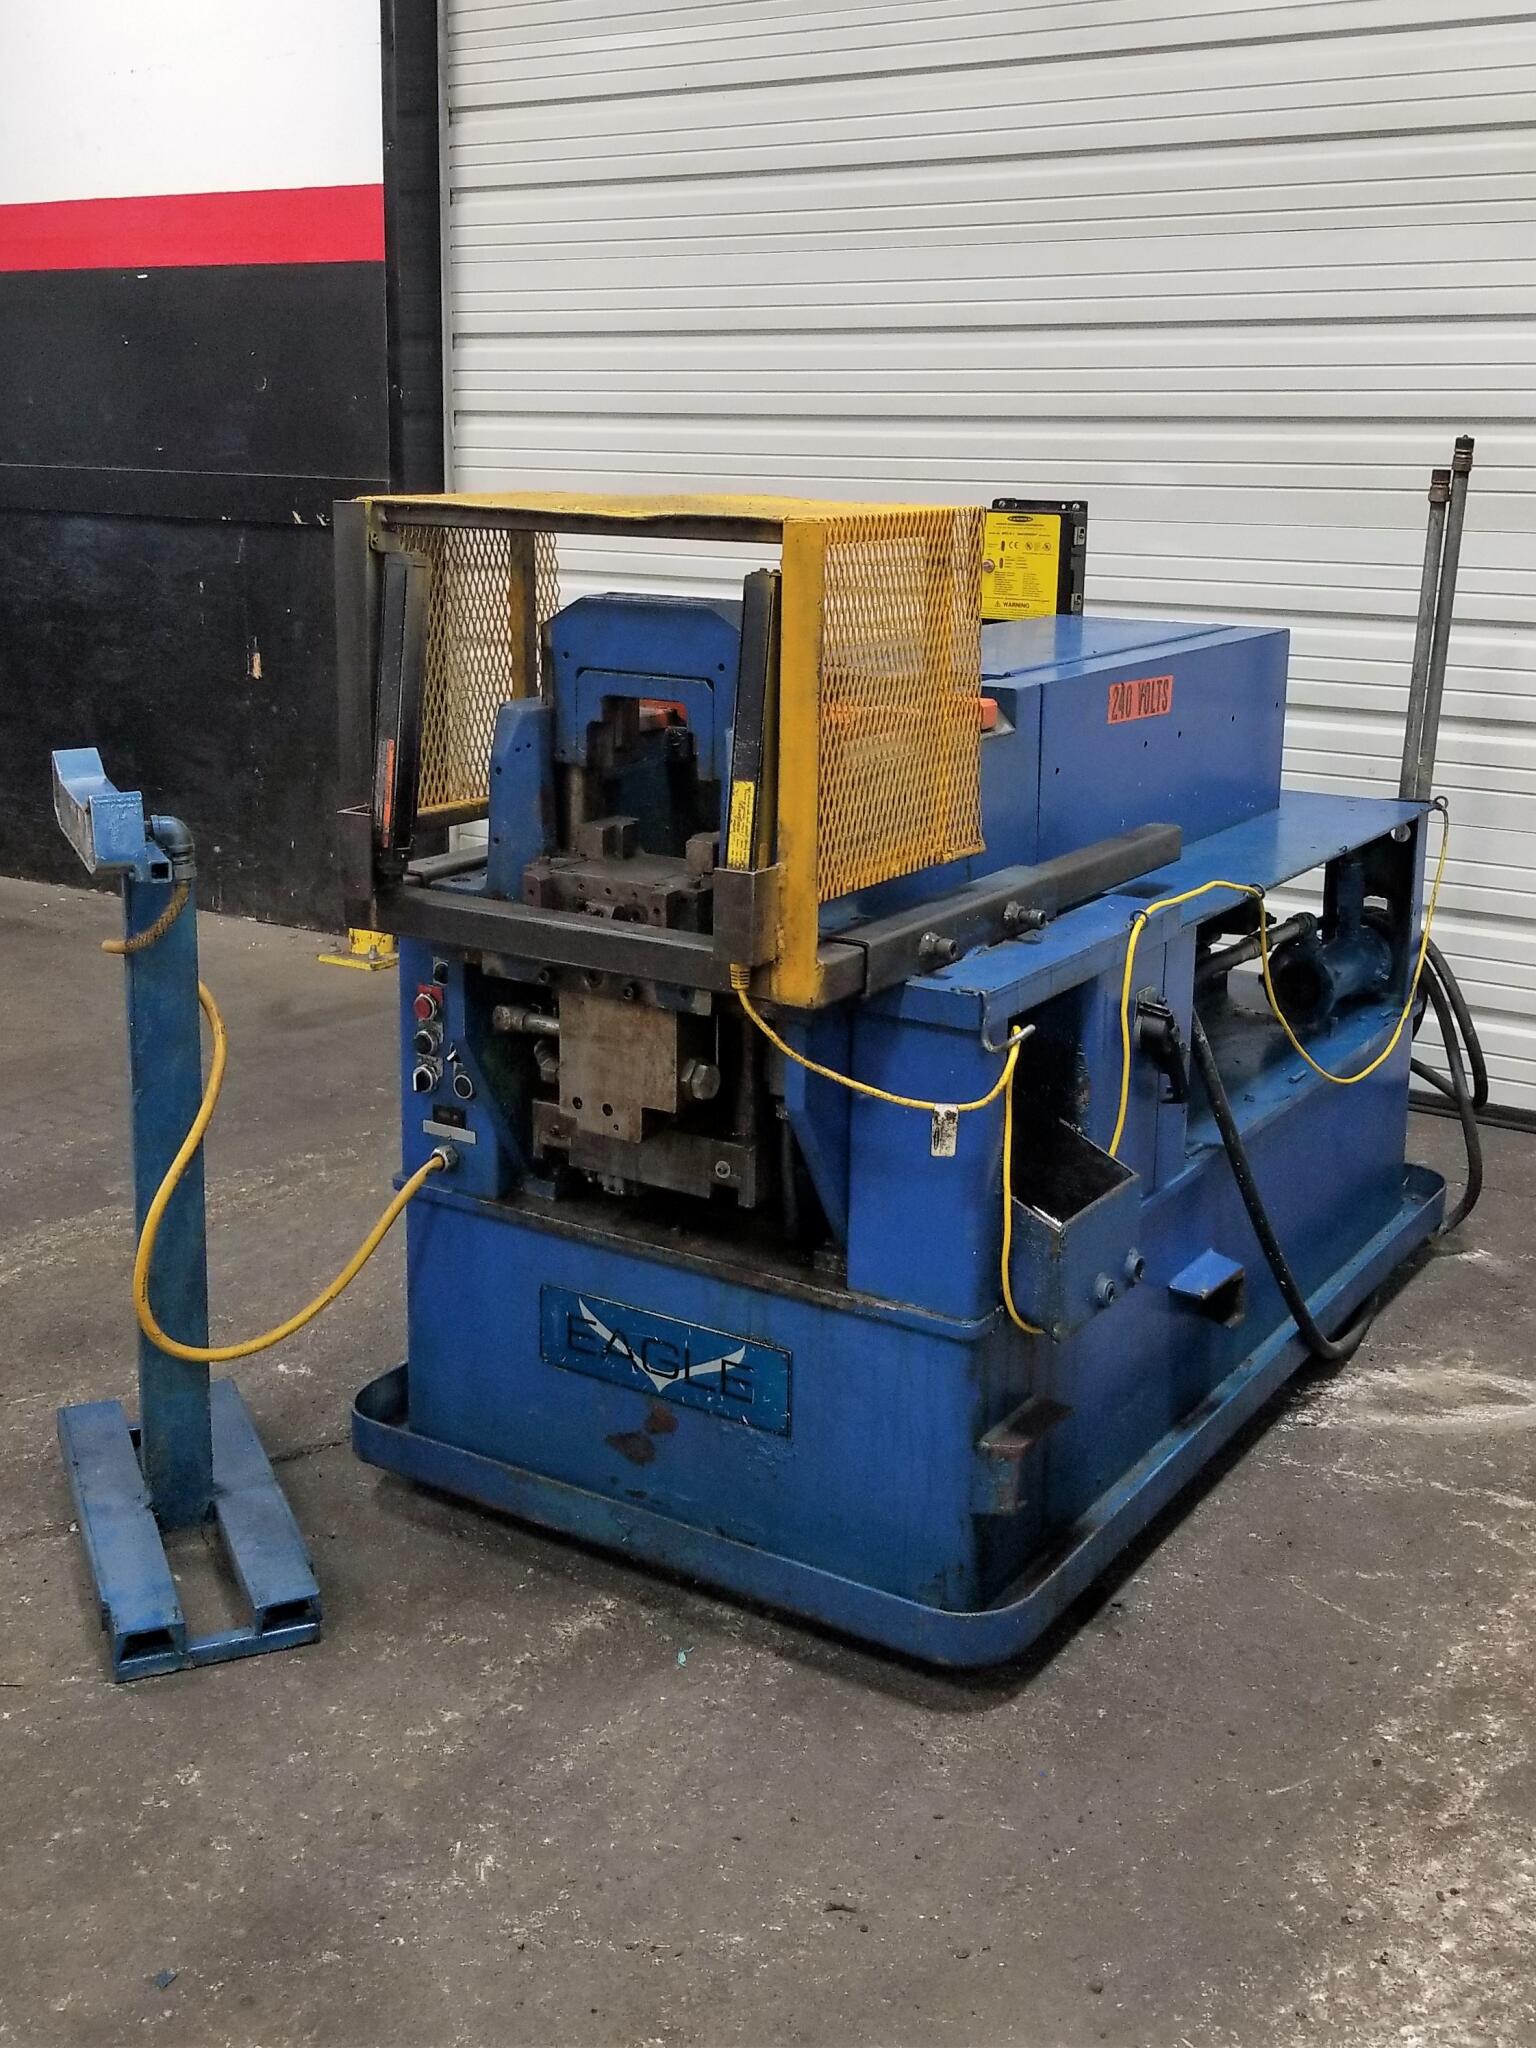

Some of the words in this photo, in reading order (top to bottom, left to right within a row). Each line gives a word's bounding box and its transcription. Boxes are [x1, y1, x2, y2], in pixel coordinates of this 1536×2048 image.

[1003, 601, 1030, 609] WARNING
[1111, 682, 1132, 720] 240
[1137, 679, 1169, 716] VOLTS
[567, 1311, 754, 1404] EAGLE
